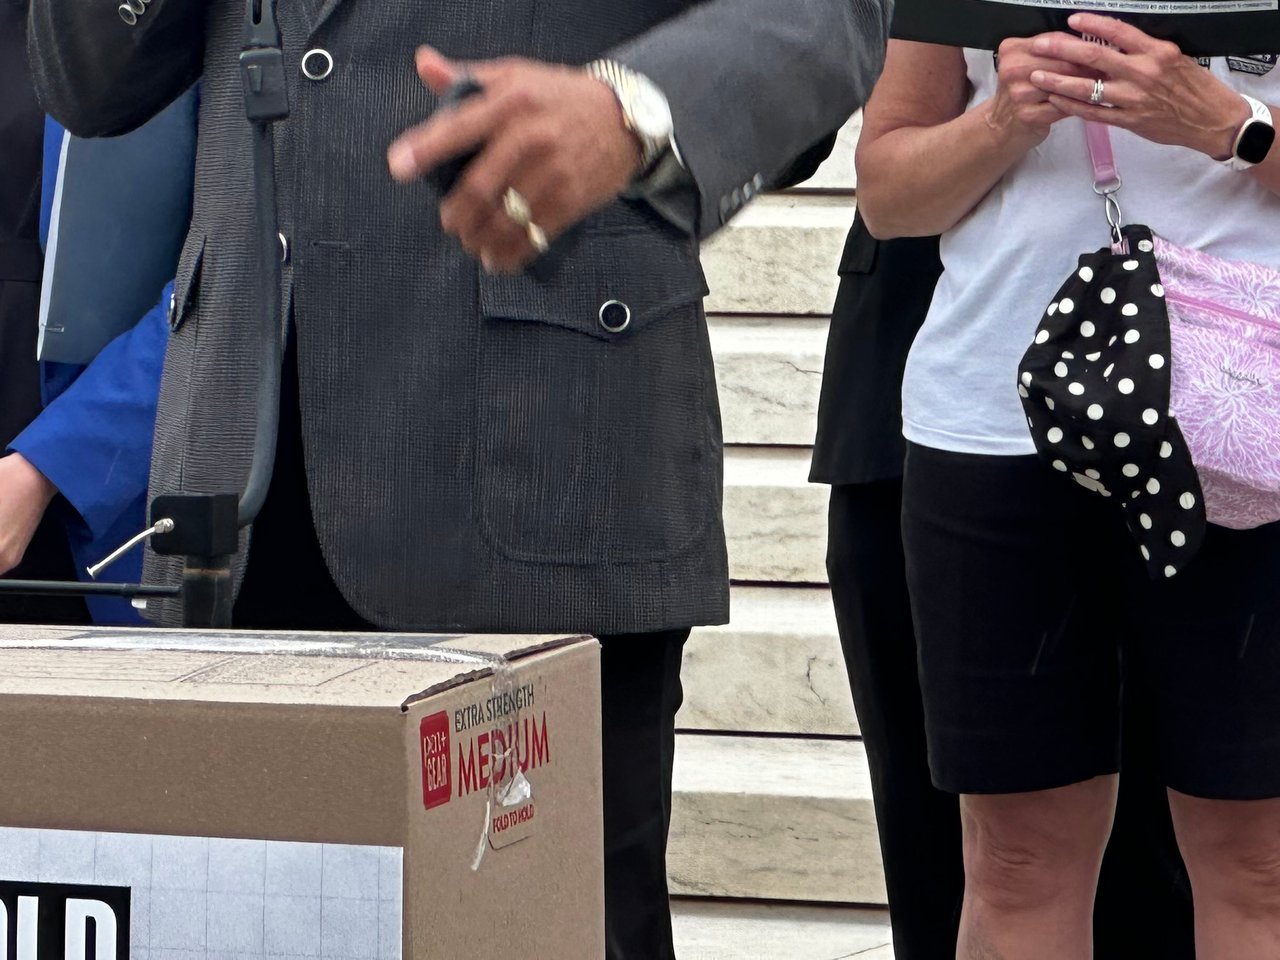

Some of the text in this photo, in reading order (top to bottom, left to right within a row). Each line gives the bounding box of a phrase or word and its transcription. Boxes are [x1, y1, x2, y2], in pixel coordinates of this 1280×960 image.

[455, 683, 534, 733] EXTRA STRENGTH
[458, 711, 550, 797] MEDIUM
[493, 804, 534, 833] FOLD TO HOLD
